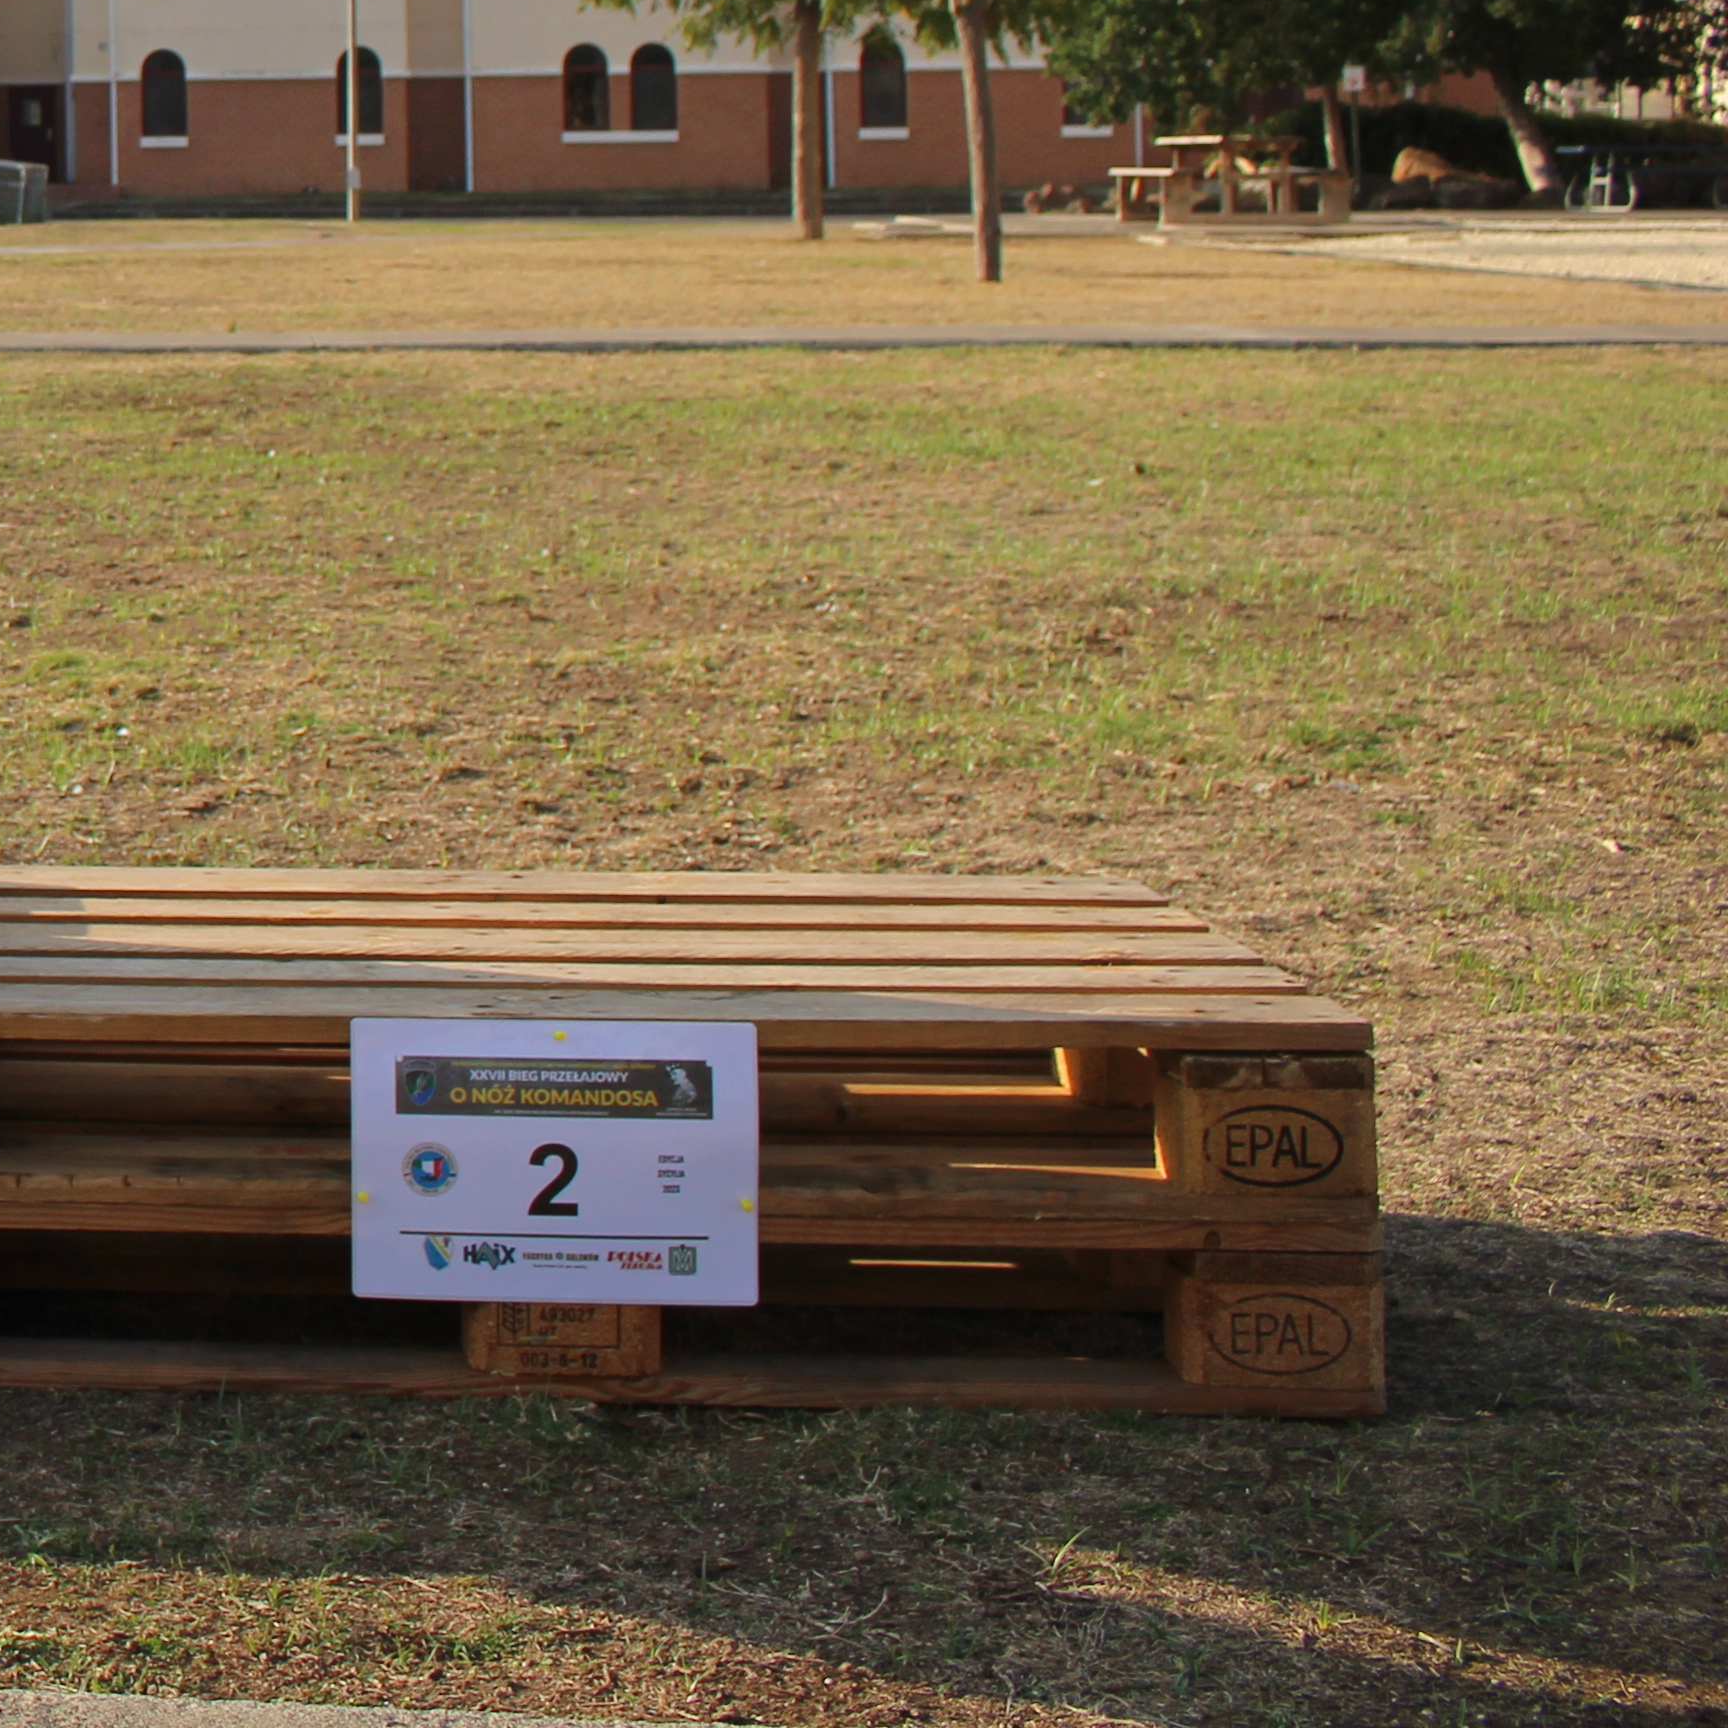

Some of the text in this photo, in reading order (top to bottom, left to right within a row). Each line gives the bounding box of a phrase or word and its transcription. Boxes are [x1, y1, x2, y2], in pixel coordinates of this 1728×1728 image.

[469, 1069, 629, 1083] XXVII BIEG PRZEŁAJOWY
[450, 1084, 659, 1107] O NÓŻ KOMANDOSA
[1225, 1124, 1323, 1168] EPAL
[527, 1142, 579, 1216] 2
[607, 1250, 663, 1263] POLSKA
[1230, 1312, 1330, 1356] EPAL
